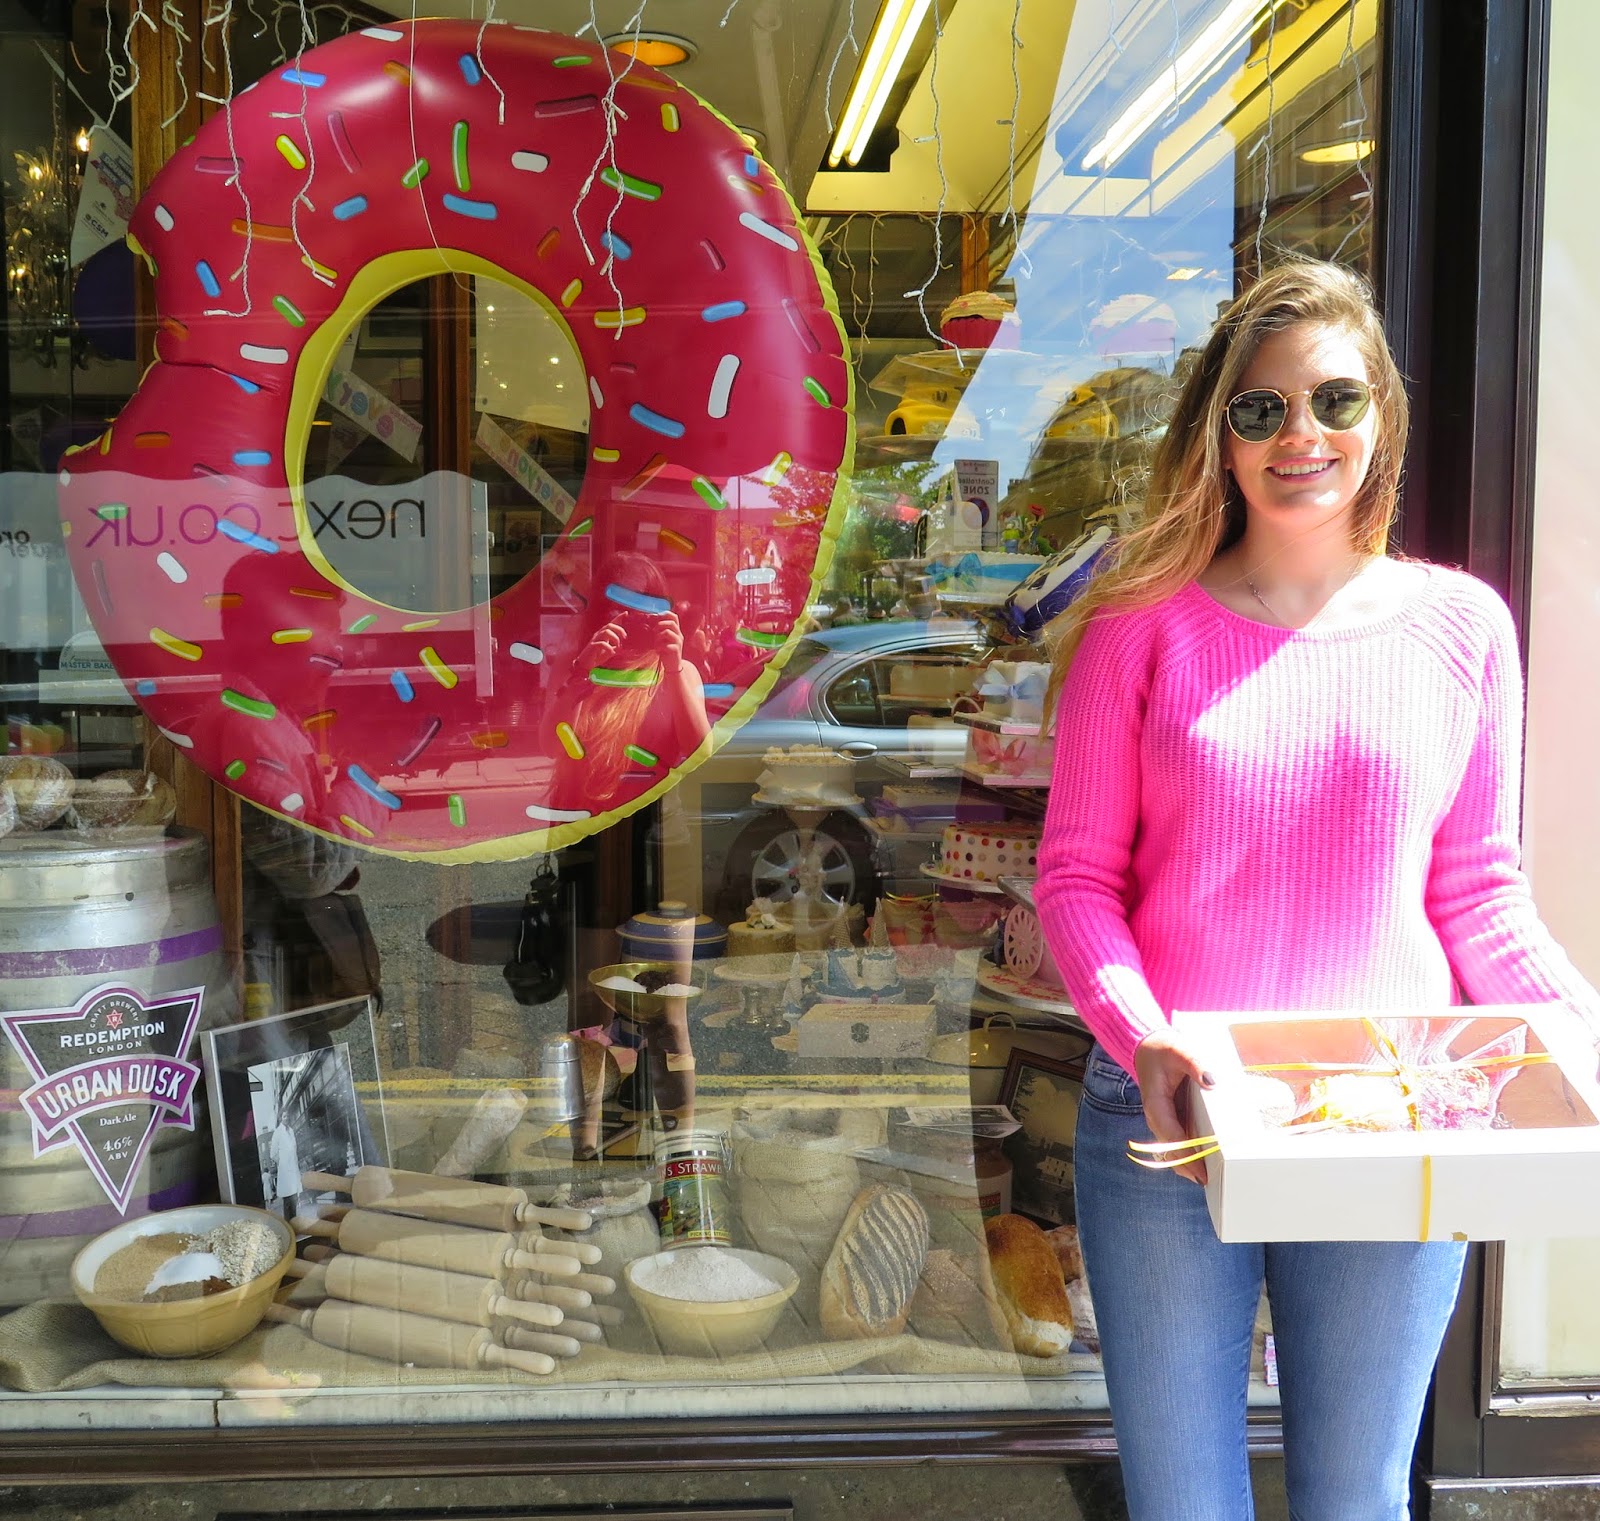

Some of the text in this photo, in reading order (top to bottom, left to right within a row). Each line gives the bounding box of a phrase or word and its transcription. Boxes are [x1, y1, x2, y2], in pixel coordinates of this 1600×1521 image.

[90, 1000, 139, 1029] CRAFT BREWERY
[60, 1021, 165, 1048] REDEMPTION
[88, 1040, 142, 1055] LONDON
[36, 1063, 186, 1119] URBAN DUSK
[99, 1113, 137, 1127] Dark Ale
[103, 1136, 133, 1152] 4.6%
[108, 1151, 128, 1161] ABV
